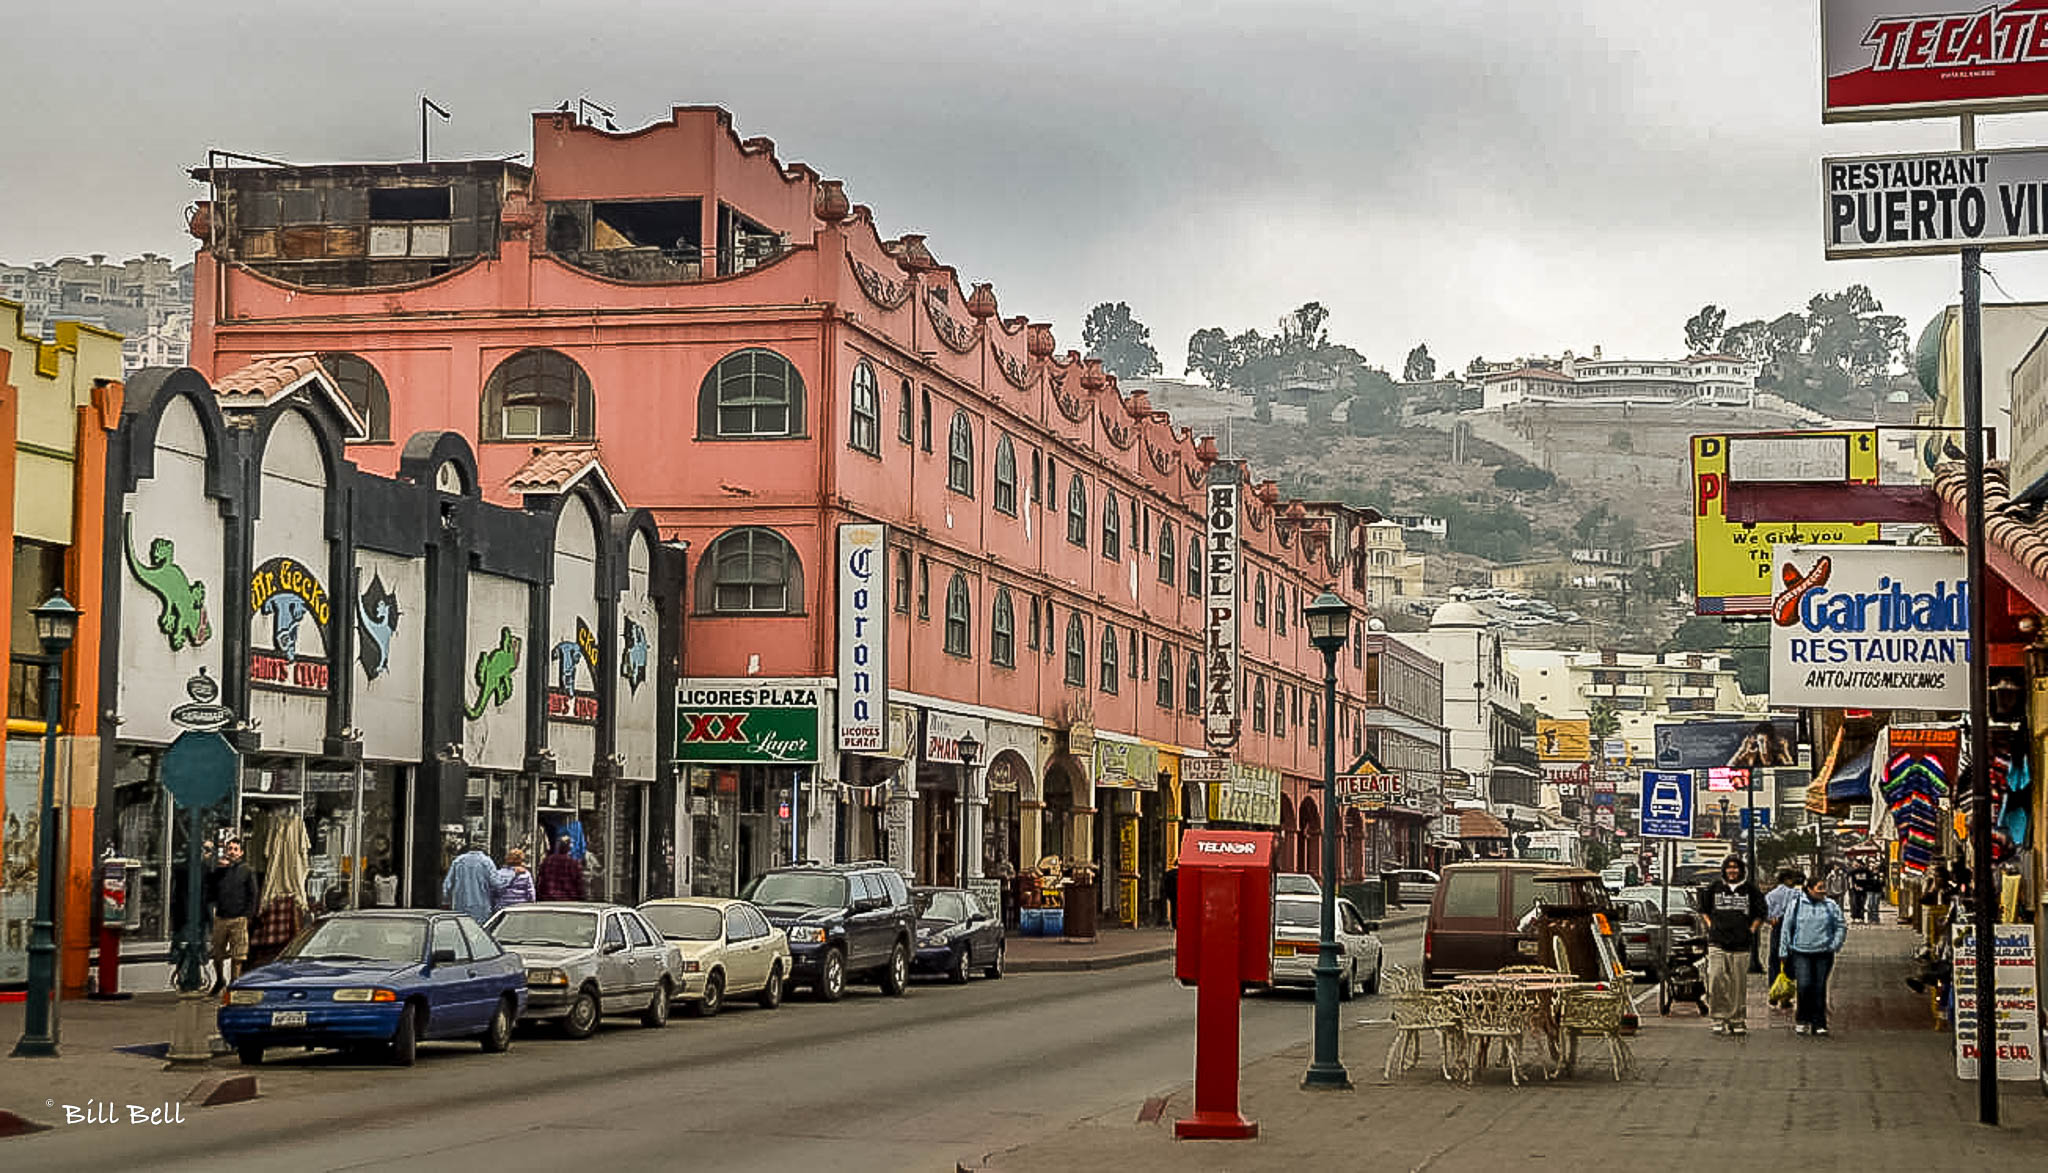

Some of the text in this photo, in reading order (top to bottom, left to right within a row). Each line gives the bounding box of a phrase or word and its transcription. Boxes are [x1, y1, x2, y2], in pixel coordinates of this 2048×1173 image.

[1831, 157, 1989, 191] RESTAURANT
[1832, 186, 1986, 244] PUERTO
[1733, 530, 1843, 545] We Give you
[1749, 549, 1774, 560] Th
[1209, 487, 1233, 715] HOTEL PLAZA
[1800, 576, 1970, 634] Garibald
[849, 547, 873, 722] Corona
[1790, 638, 1971, 664] RESTAURANT
[1804, 670, 1881, 688] ANTOJITOS
[678, 690, 818, 706] LICORES PLAZA
[681, 713, 750, 743] XX
[841, 727, 880, 737] LICORES
[844, 738, 877, 748] PLAZA
[1184, 759, 1229, 771] HOTEL
[1337, 774, 1401, 792] TECATE
